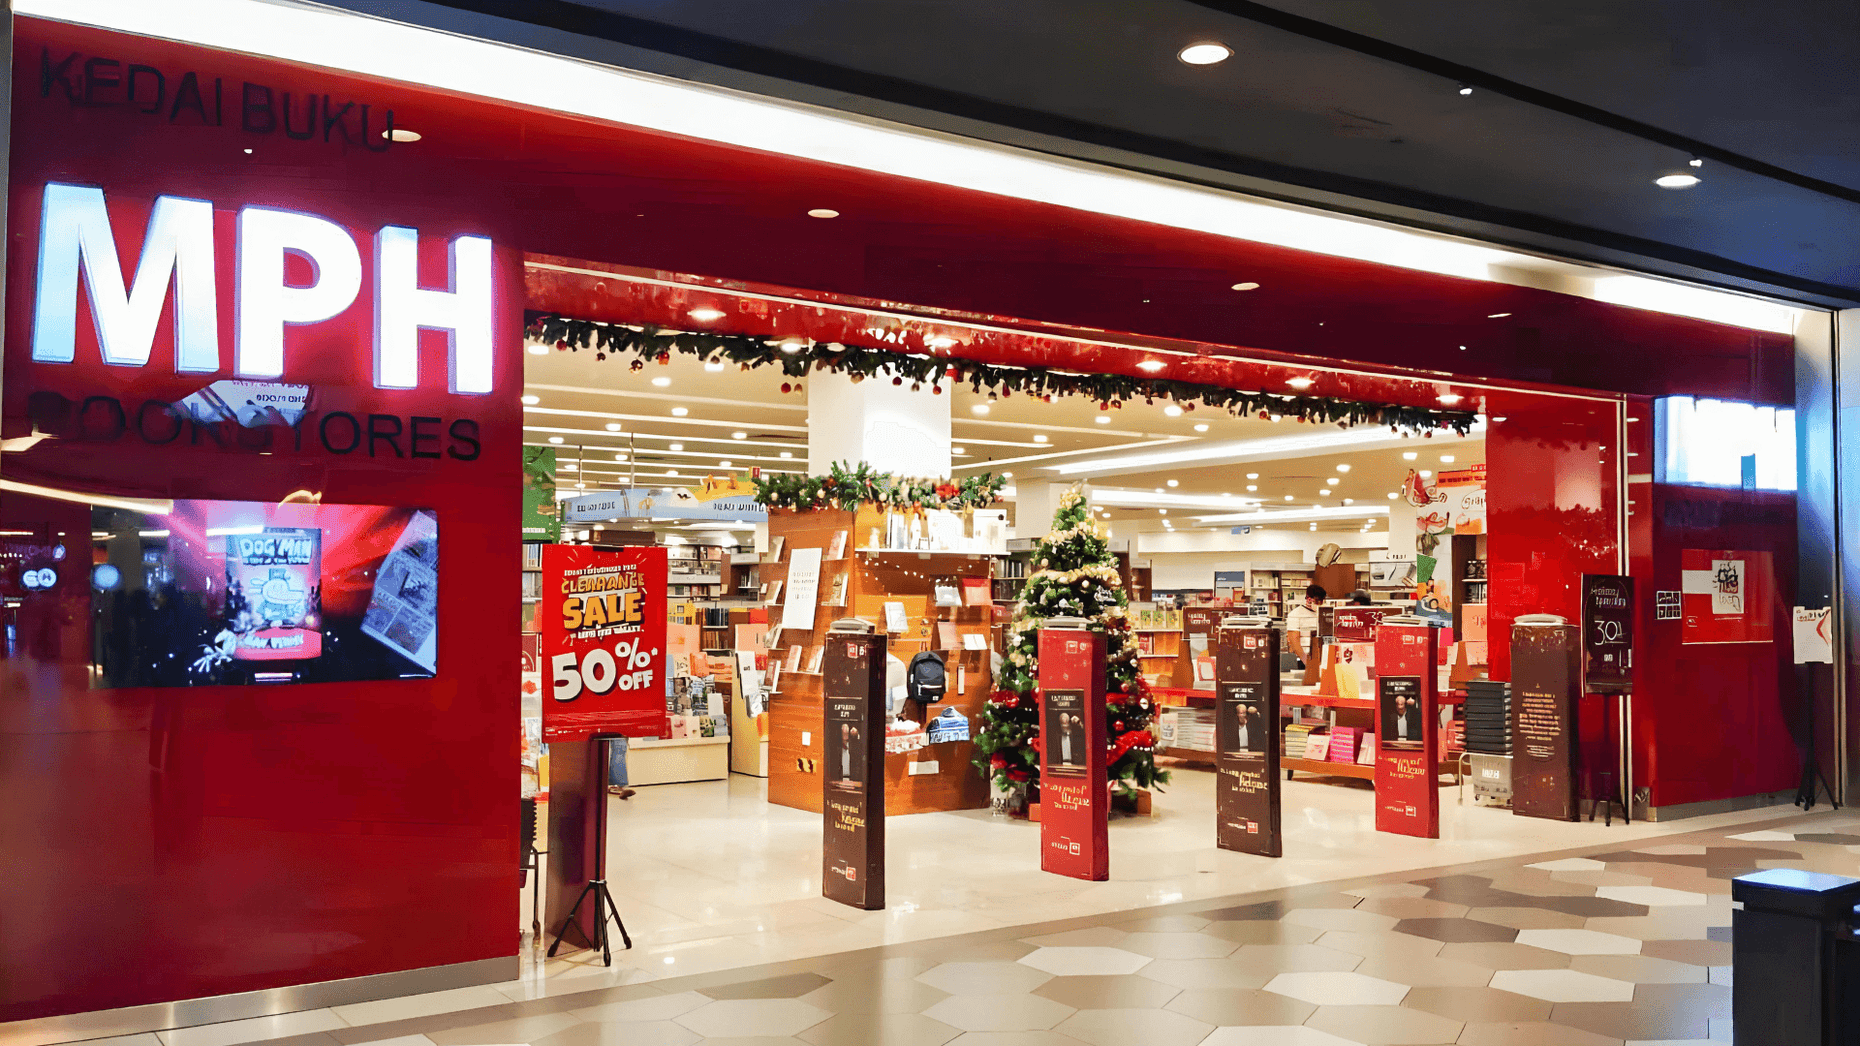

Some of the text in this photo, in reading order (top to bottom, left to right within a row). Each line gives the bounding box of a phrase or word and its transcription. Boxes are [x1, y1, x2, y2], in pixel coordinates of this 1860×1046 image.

[41, 47, 393, 151] KEDAI BUKU
[31, 180, 494, 395] MPH
[239, 538, 275, 558] DOG
[562, 593, 642, 630] SALE
[618, 669, 654, 691] OFF
